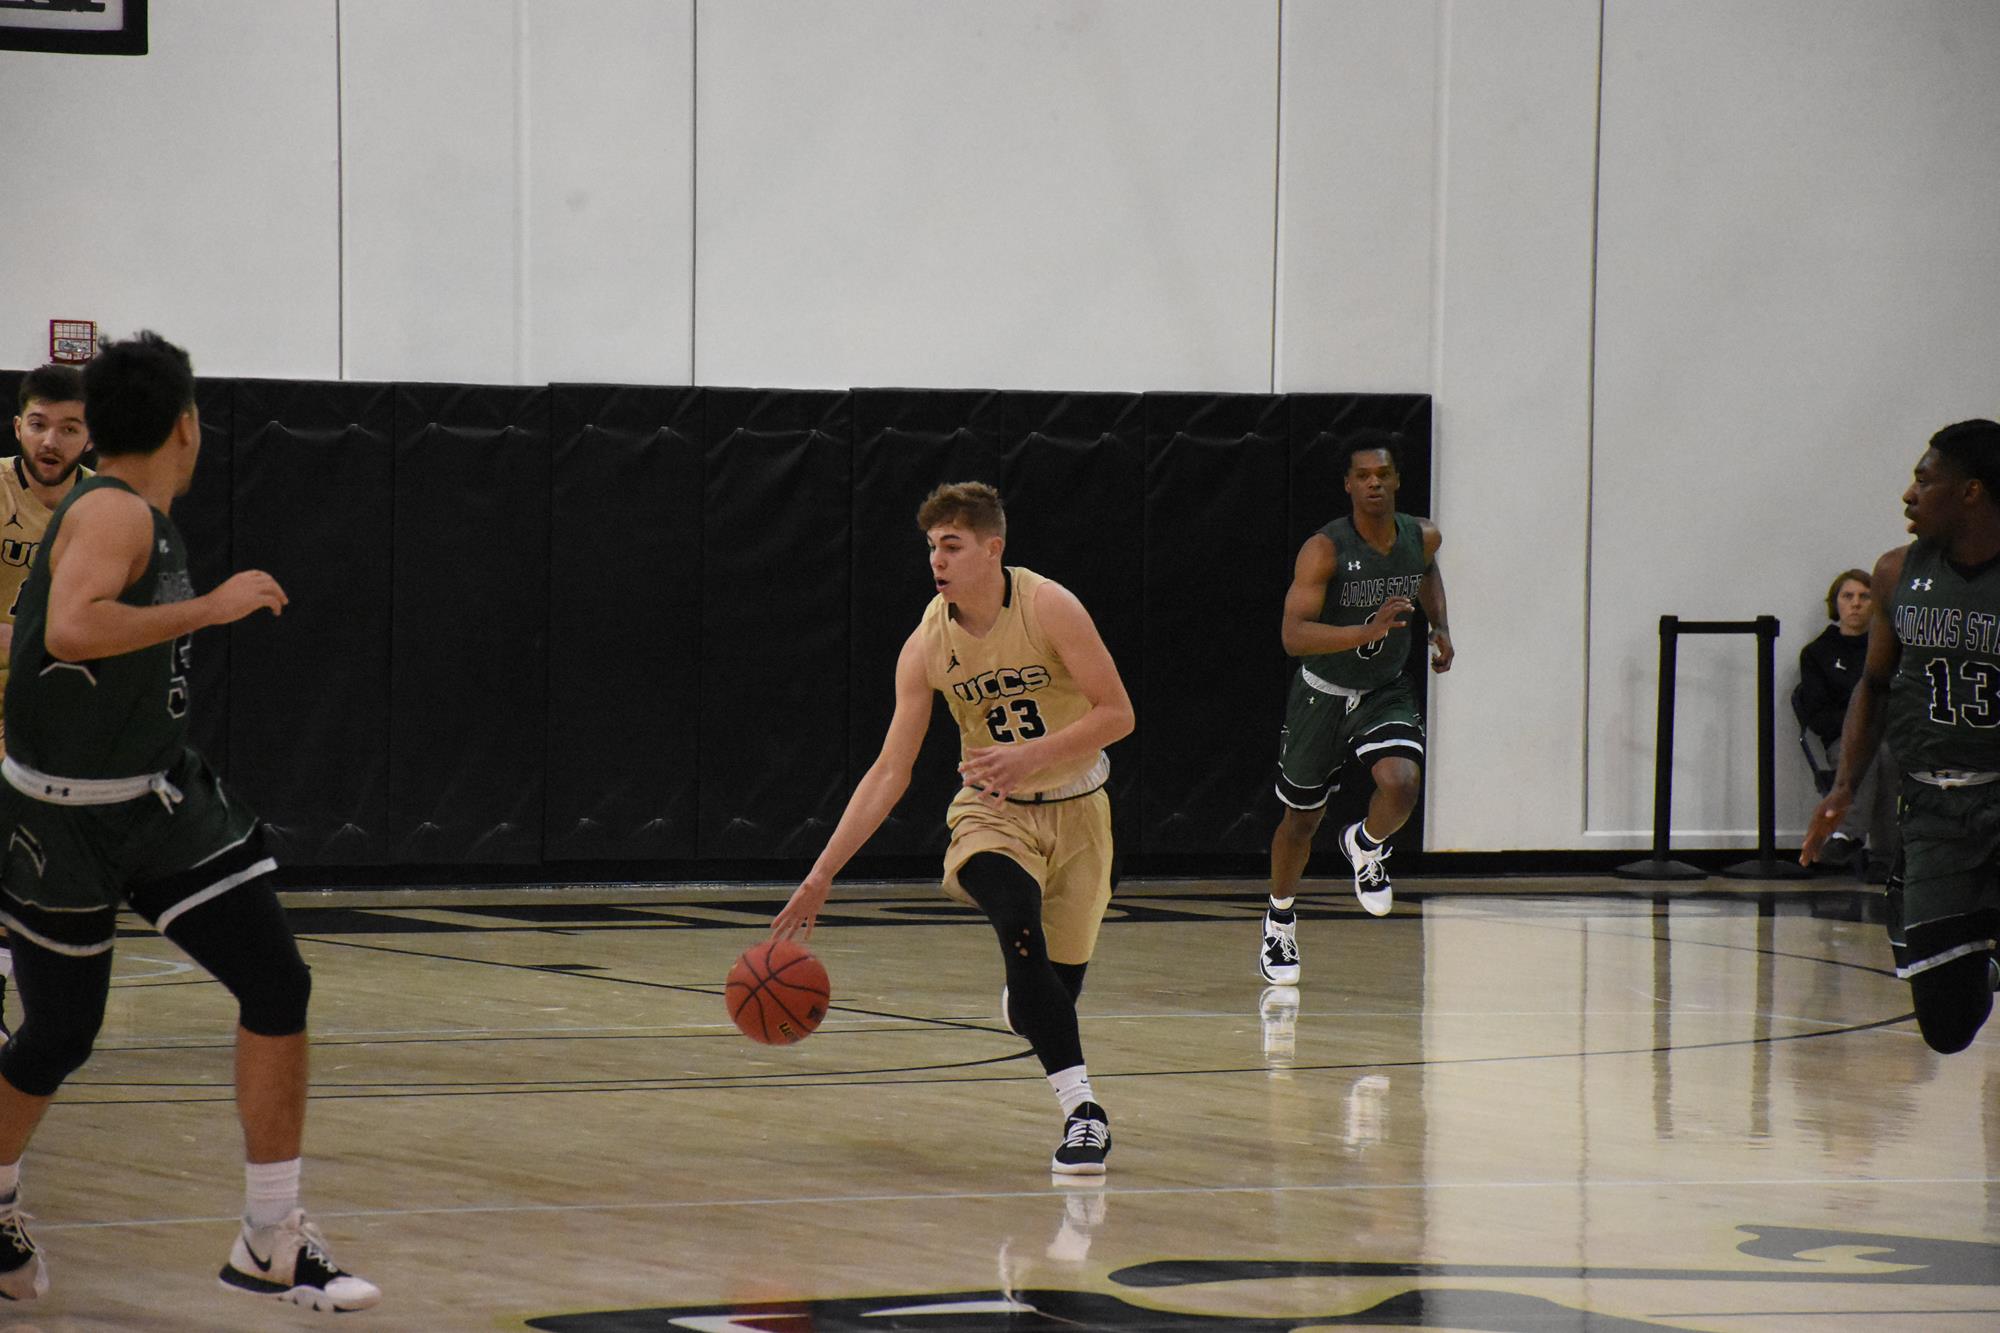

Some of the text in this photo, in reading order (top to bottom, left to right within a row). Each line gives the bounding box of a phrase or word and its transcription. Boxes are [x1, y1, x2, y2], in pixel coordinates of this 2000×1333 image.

[1340, 578, 1385, 608] ADAMS
[1895, 605, 1962, 648] ADAMS
[953, 665, 1052, 706] UCCS
[1925, 657, 2000, 729] 13
[985, 699, 1047, 743] 23
